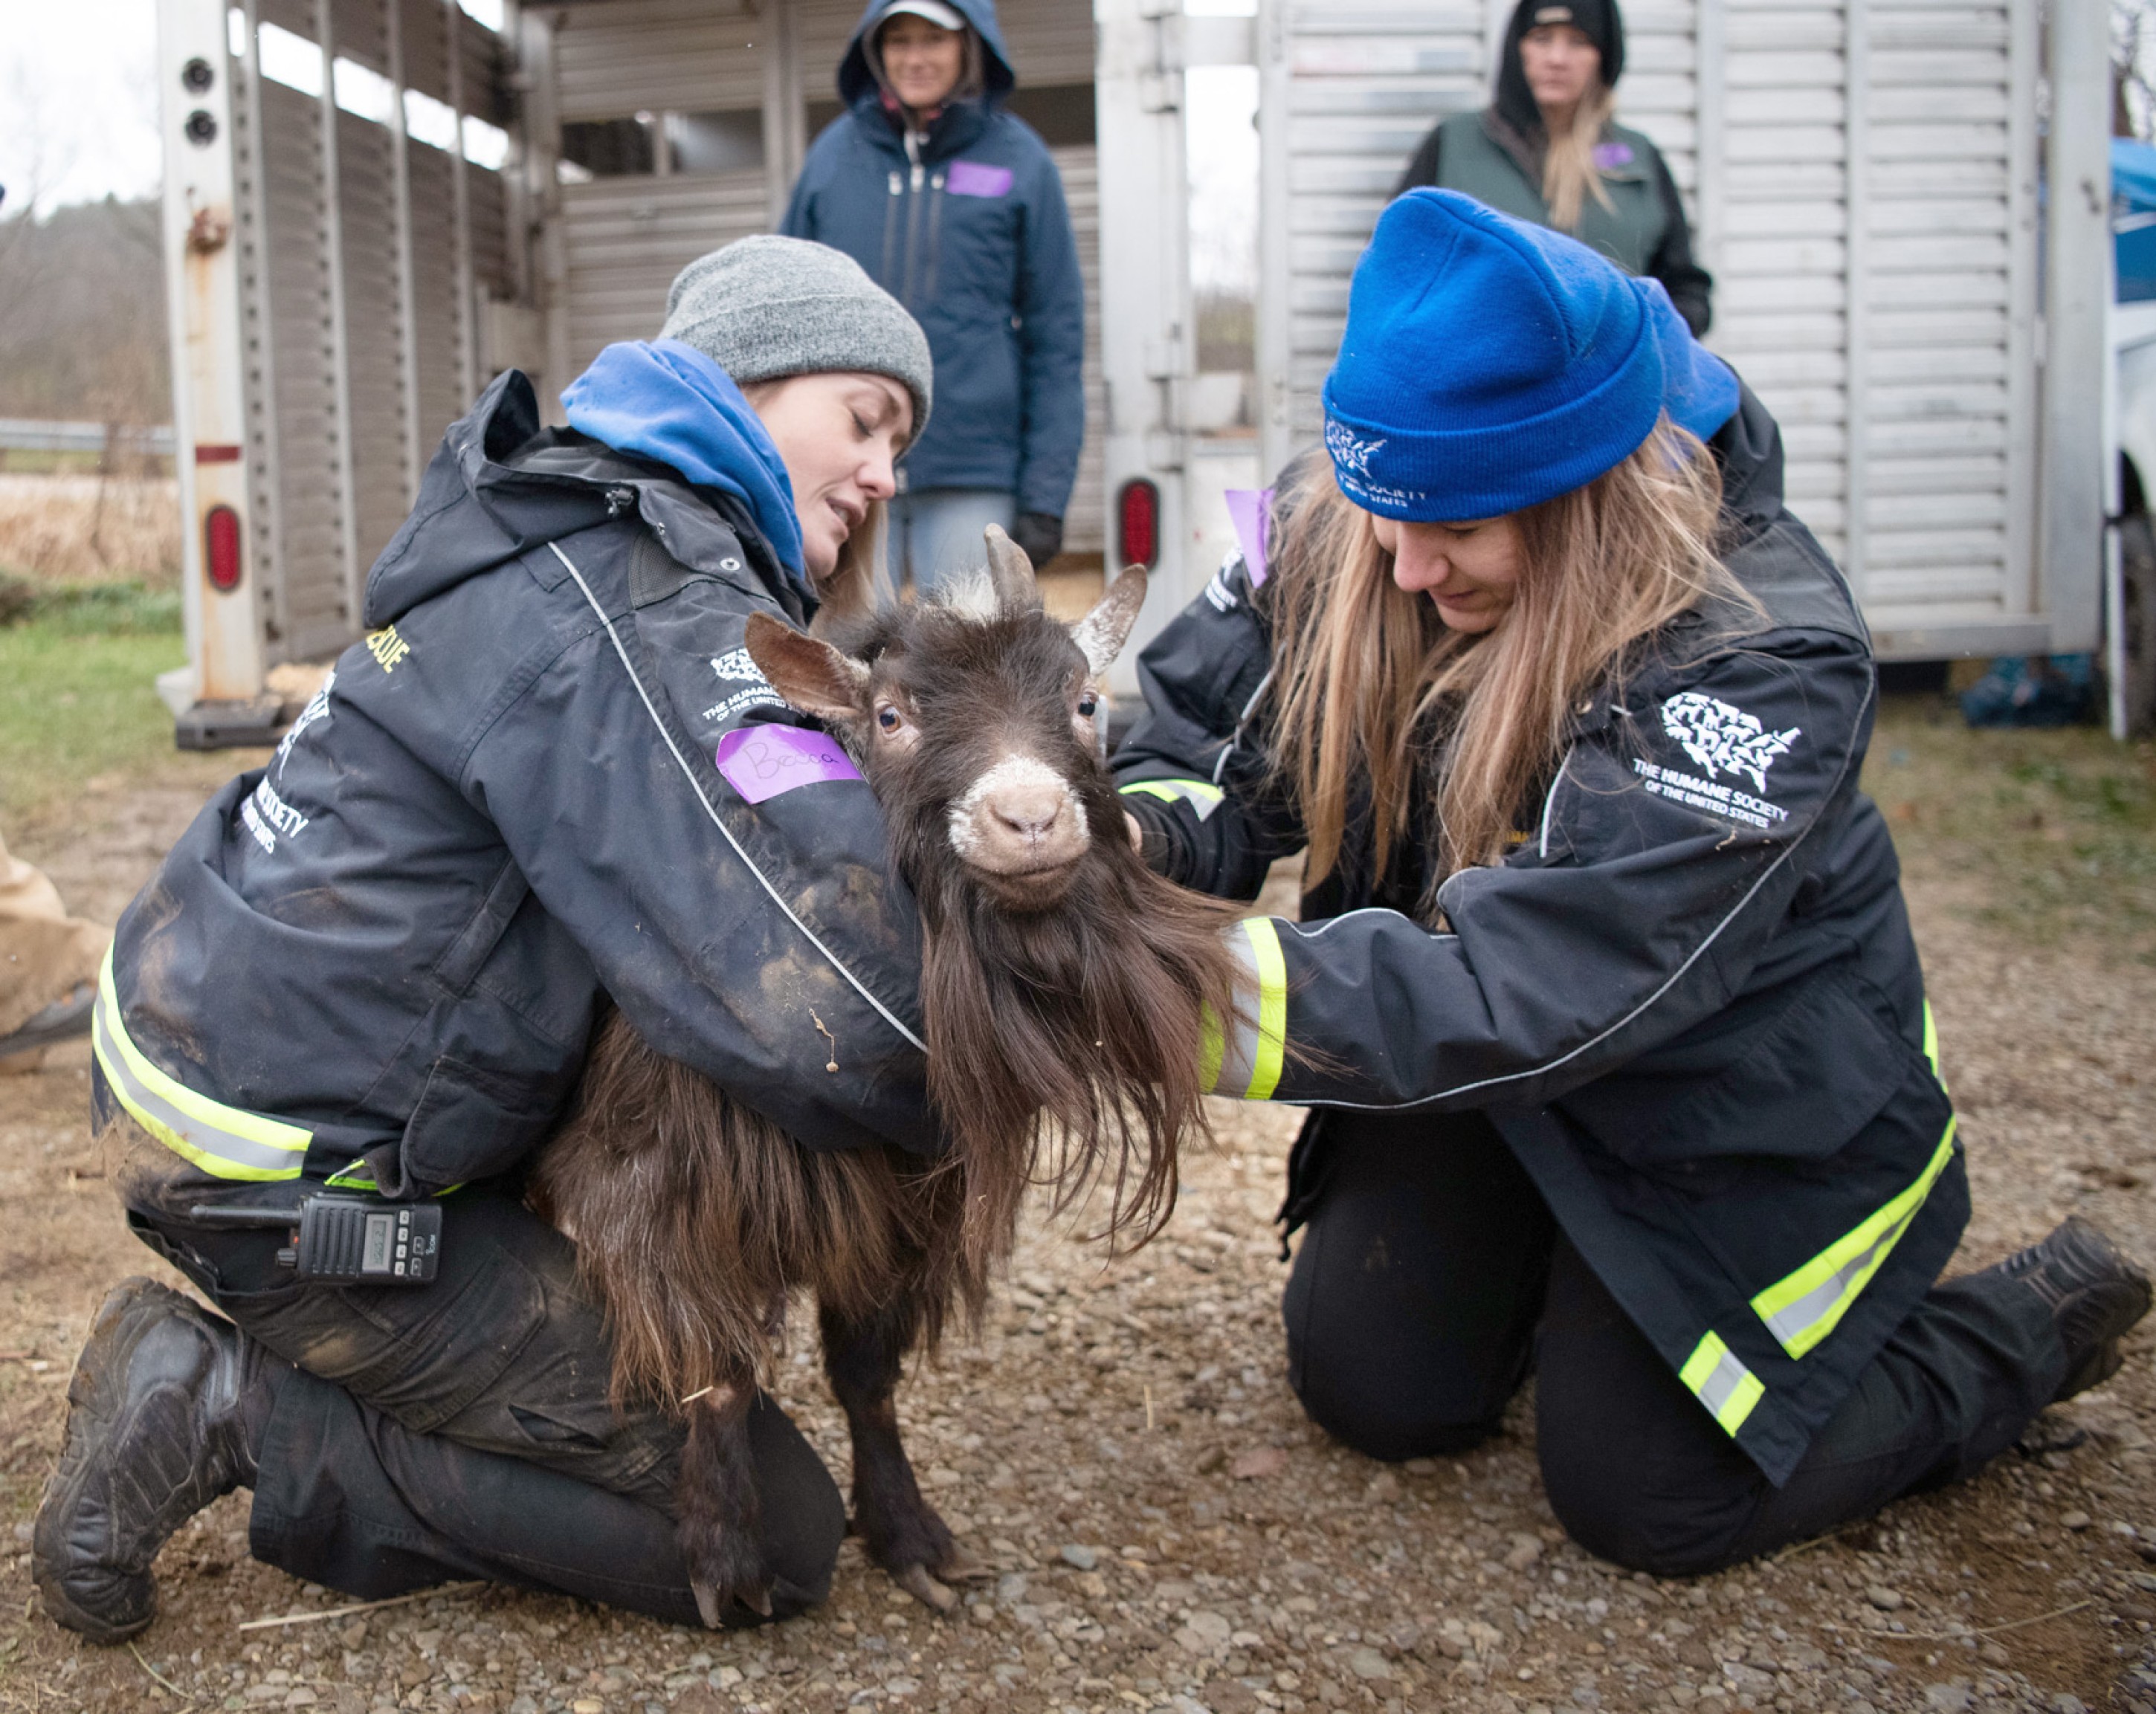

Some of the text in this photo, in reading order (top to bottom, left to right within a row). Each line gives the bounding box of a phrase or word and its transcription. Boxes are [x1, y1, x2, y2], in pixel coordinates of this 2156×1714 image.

[703, 701, 728, 719] THE
[717, 697, 786, 721] OF THE UNITED
[1633, 758, 1789, 821] THE HUMANE SOCIETY
[1645, 780, 1770, 828] OF THE UNITED STATES
